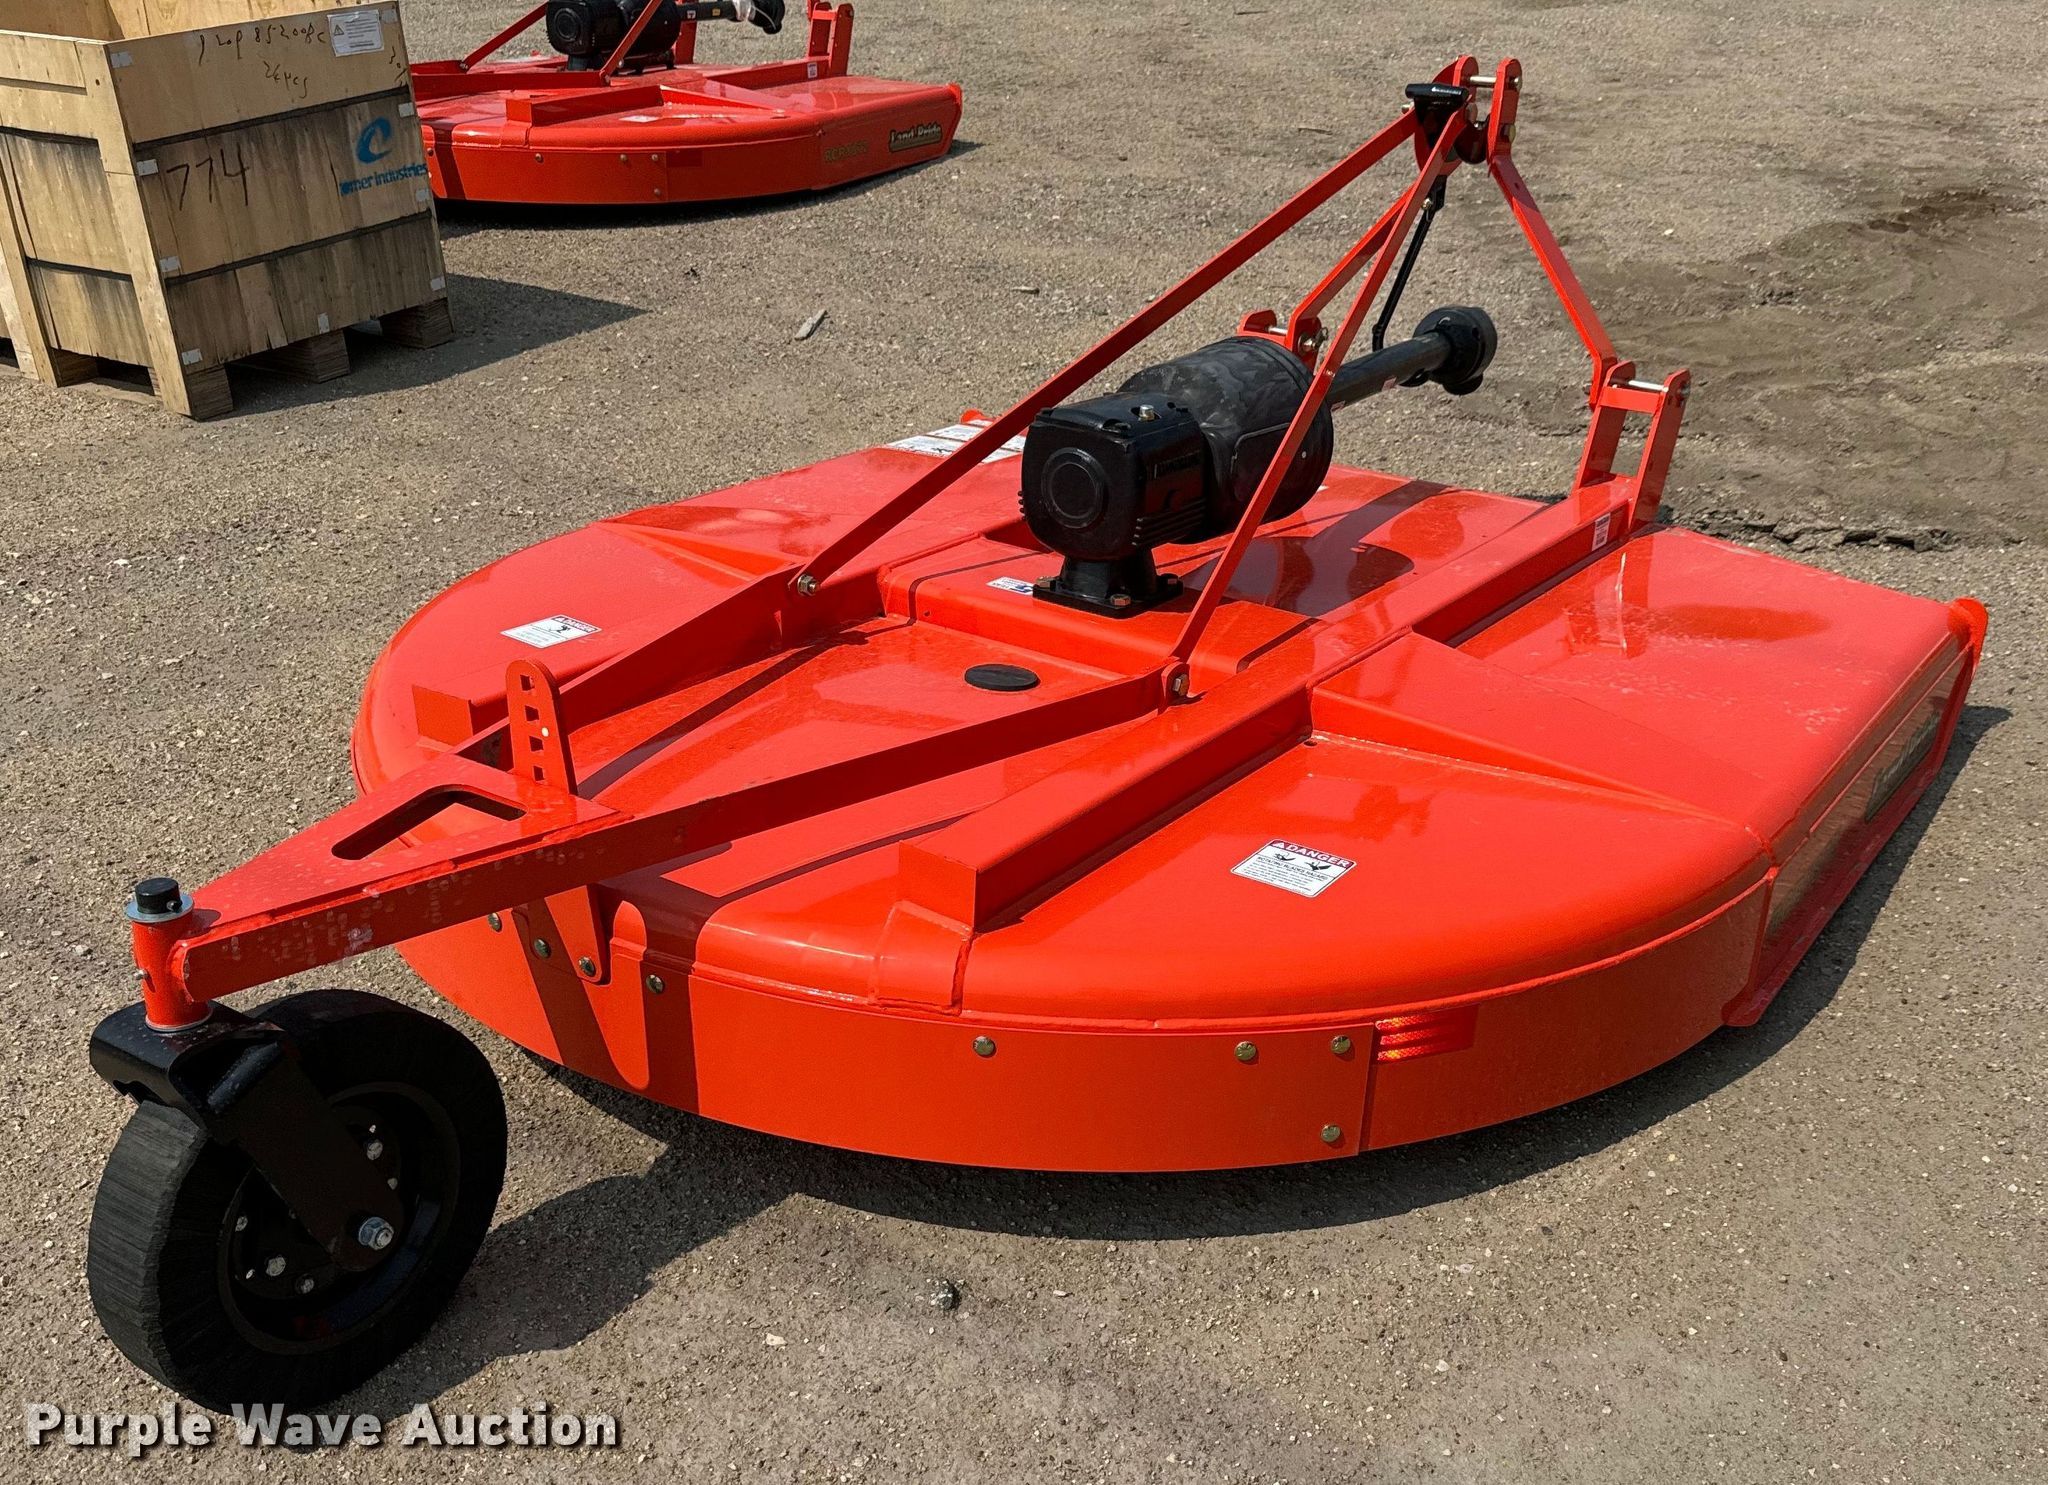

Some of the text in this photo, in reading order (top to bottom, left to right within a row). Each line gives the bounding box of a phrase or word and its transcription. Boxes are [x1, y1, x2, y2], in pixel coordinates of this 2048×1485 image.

[340, 163, 428, 197] mer industries
[1284, 845, 1350, 866] DANGER
